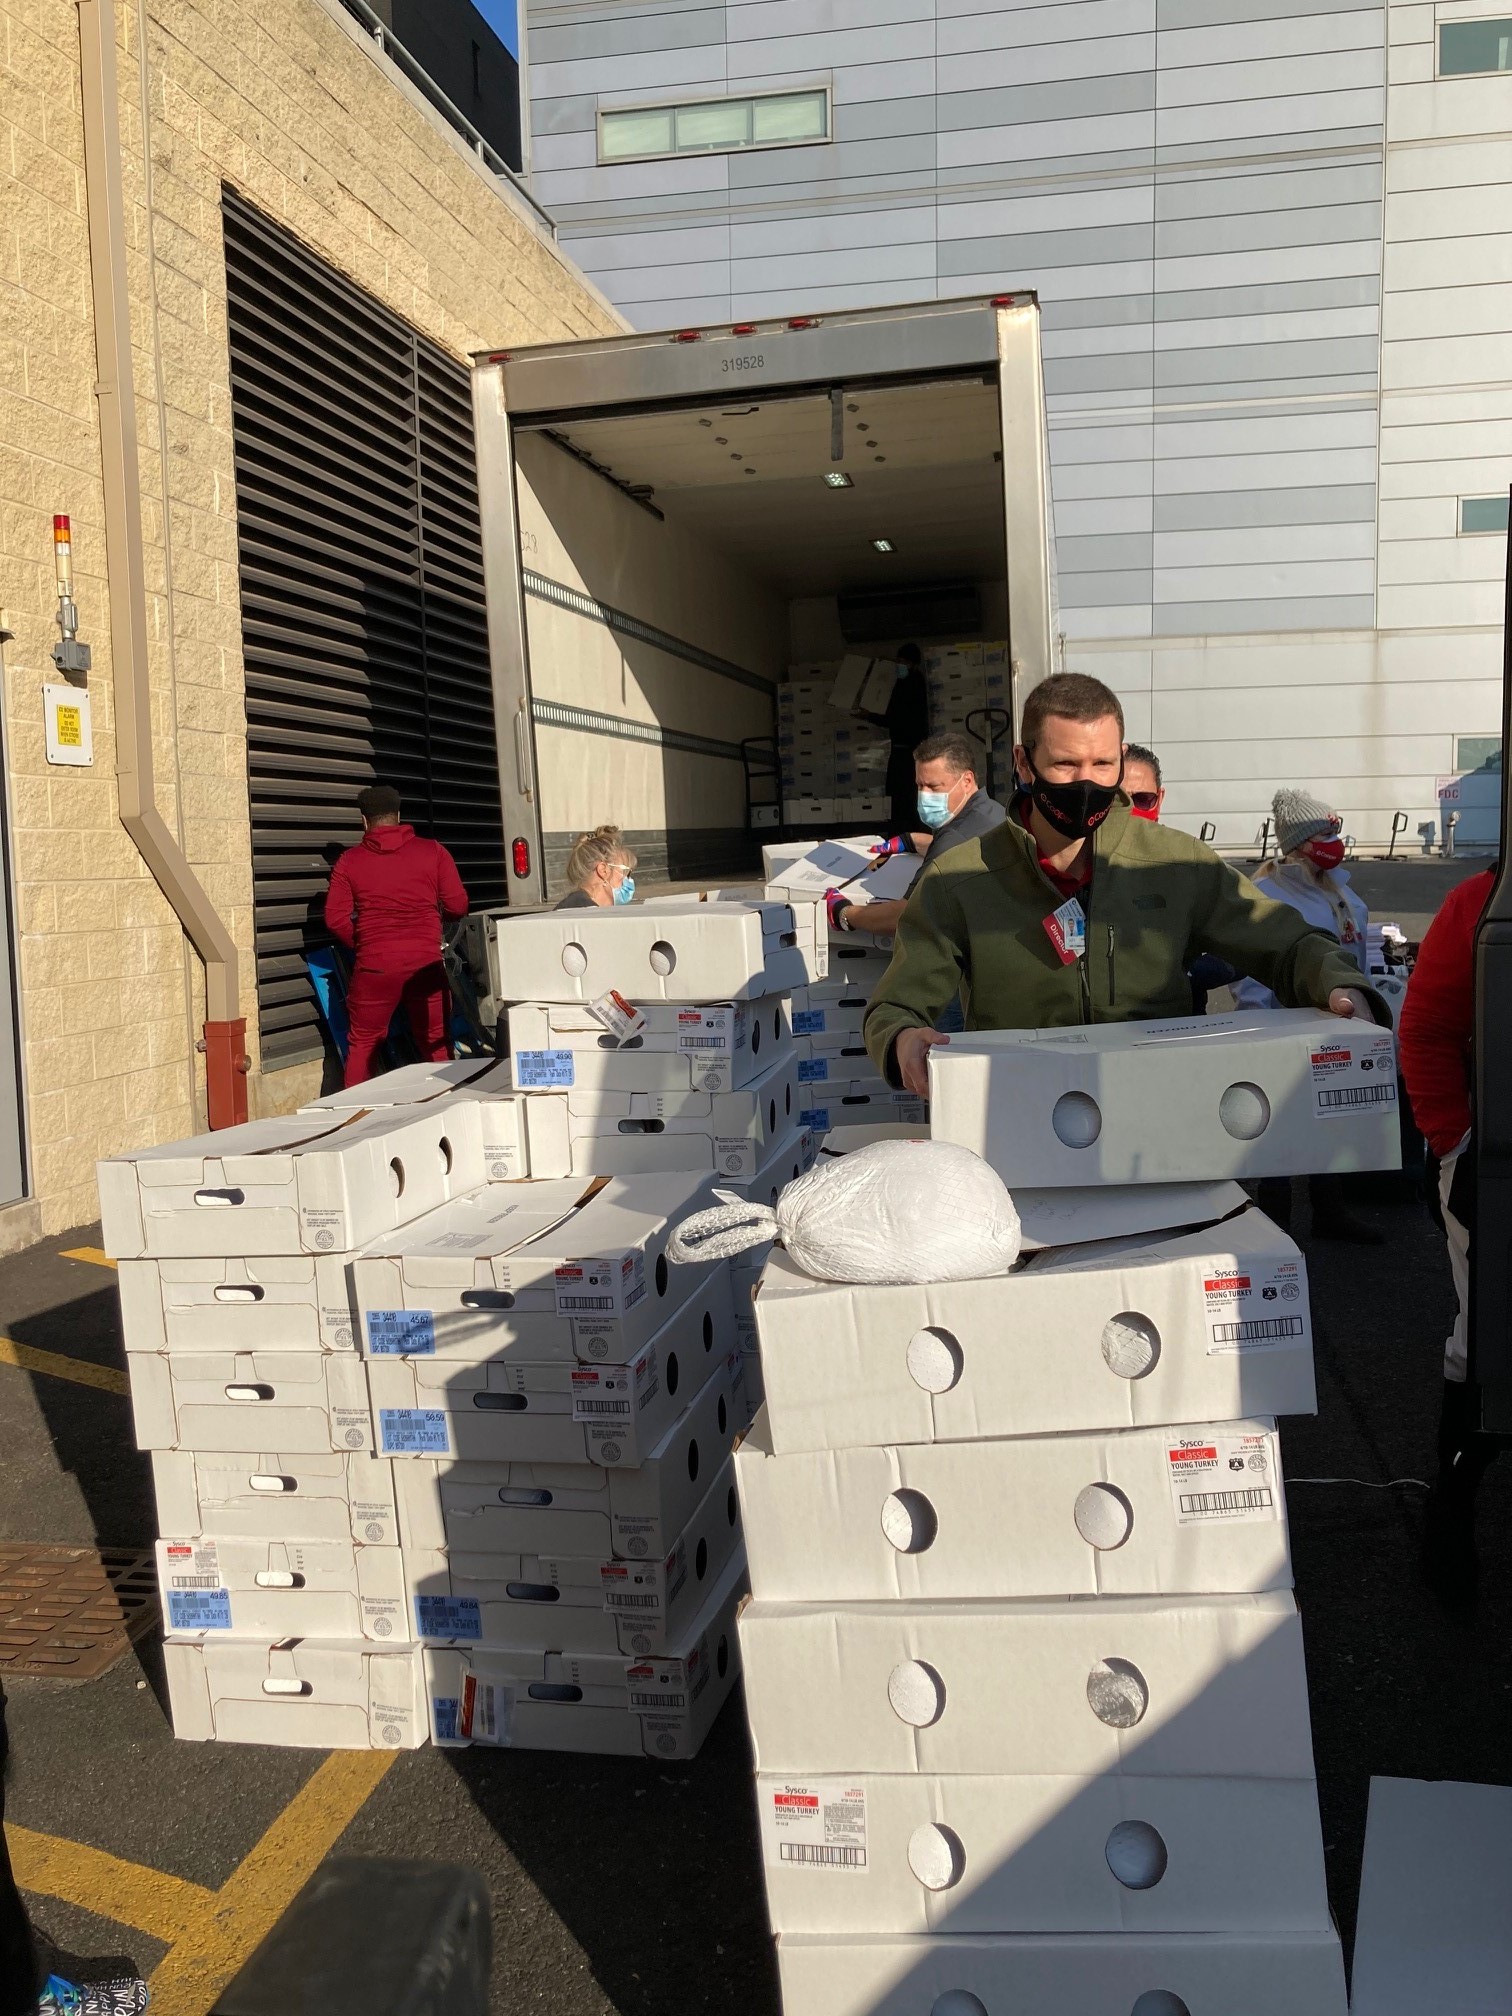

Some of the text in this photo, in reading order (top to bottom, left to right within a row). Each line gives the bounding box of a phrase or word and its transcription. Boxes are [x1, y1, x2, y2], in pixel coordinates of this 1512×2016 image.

[721, 355, 764, 372] 319528
[1438, 790, 1458, 798] FDC
[1321, 1045, 1340, 1053] Sysco
[1318, 1053, 1345, 1062] Classic
[1215, 1270, 1238, 1278] Sysco
[1212, 1280, 1243, 1289] Classic
[1205, 1289, 1252, 1299] YOUNG TURKEY
[1180, 1440, 1203, 1448] Sysco
[1178, 1450, 1209, 1460] Classic
[785, 1786, 807, 1794] Sysco
[782, 1796, 810, 1805] Classic
